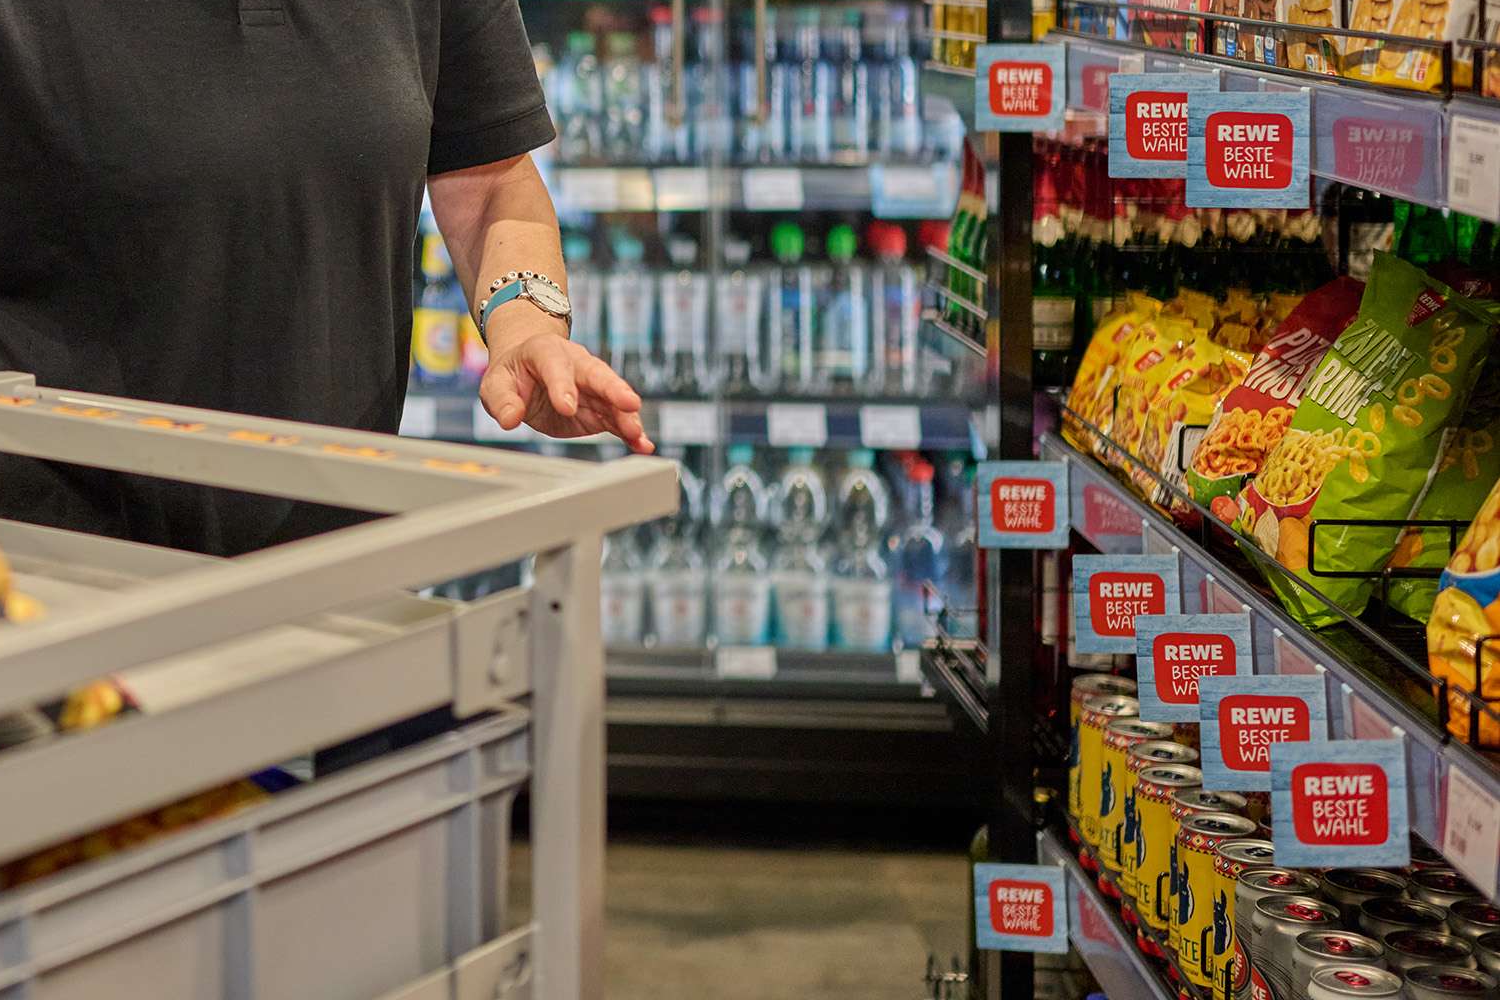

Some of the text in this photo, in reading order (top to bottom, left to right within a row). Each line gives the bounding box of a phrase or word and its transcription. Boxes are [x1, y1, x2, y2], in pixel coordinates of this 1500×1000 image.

[997, 68, 1043, 85] REWE
[1002, 85, 1039, 100] BESTE
[1002, 99, 1040, 112] WAHL
[1137, 102, 1188, 119] REWE
[1142, 122, 1188, 138] BESTE
[1217, 124, 1280, 143] REWE
[1142, 137, 1188, 153] WAHL
[1224, 146, 1274, 163] BESTE
[1224, 163, 1275, 180] WAHL
[1268, 327, 1331, 367] PIZ
[1306, 358, 1383, 426] RINGE
[999, 485, 1046, 501] REWE
[1004, 502, 1042, 516] BESTE
[1004, 514, 1042, 529] WAHL
[1100, 582, 1153, 598] REWE
[1106, 601, 1149, 616] BESTE
[1107, 615, 1136, 630] WA
[1164, 644, 1223, 661] REWE
[1172, 665, 1218, 681] BESTE
[1172, 680, 1200, 696] WA
[1231, 707, 1296, 725] REWE
[1238, 729, 1290, 746] BESTE
[1239, 746, 1270, 763] WA
[1304, 775, 1374, 796] REWE
[1312, 799, 1369, 819] BESTE
[1313, 817, 1370, 839] WAHL
[996, 887, 1045, 904] REWE
[1003, 903, 1041, 919] BESTE
[1003, 917, 1042, 931] WAHL
